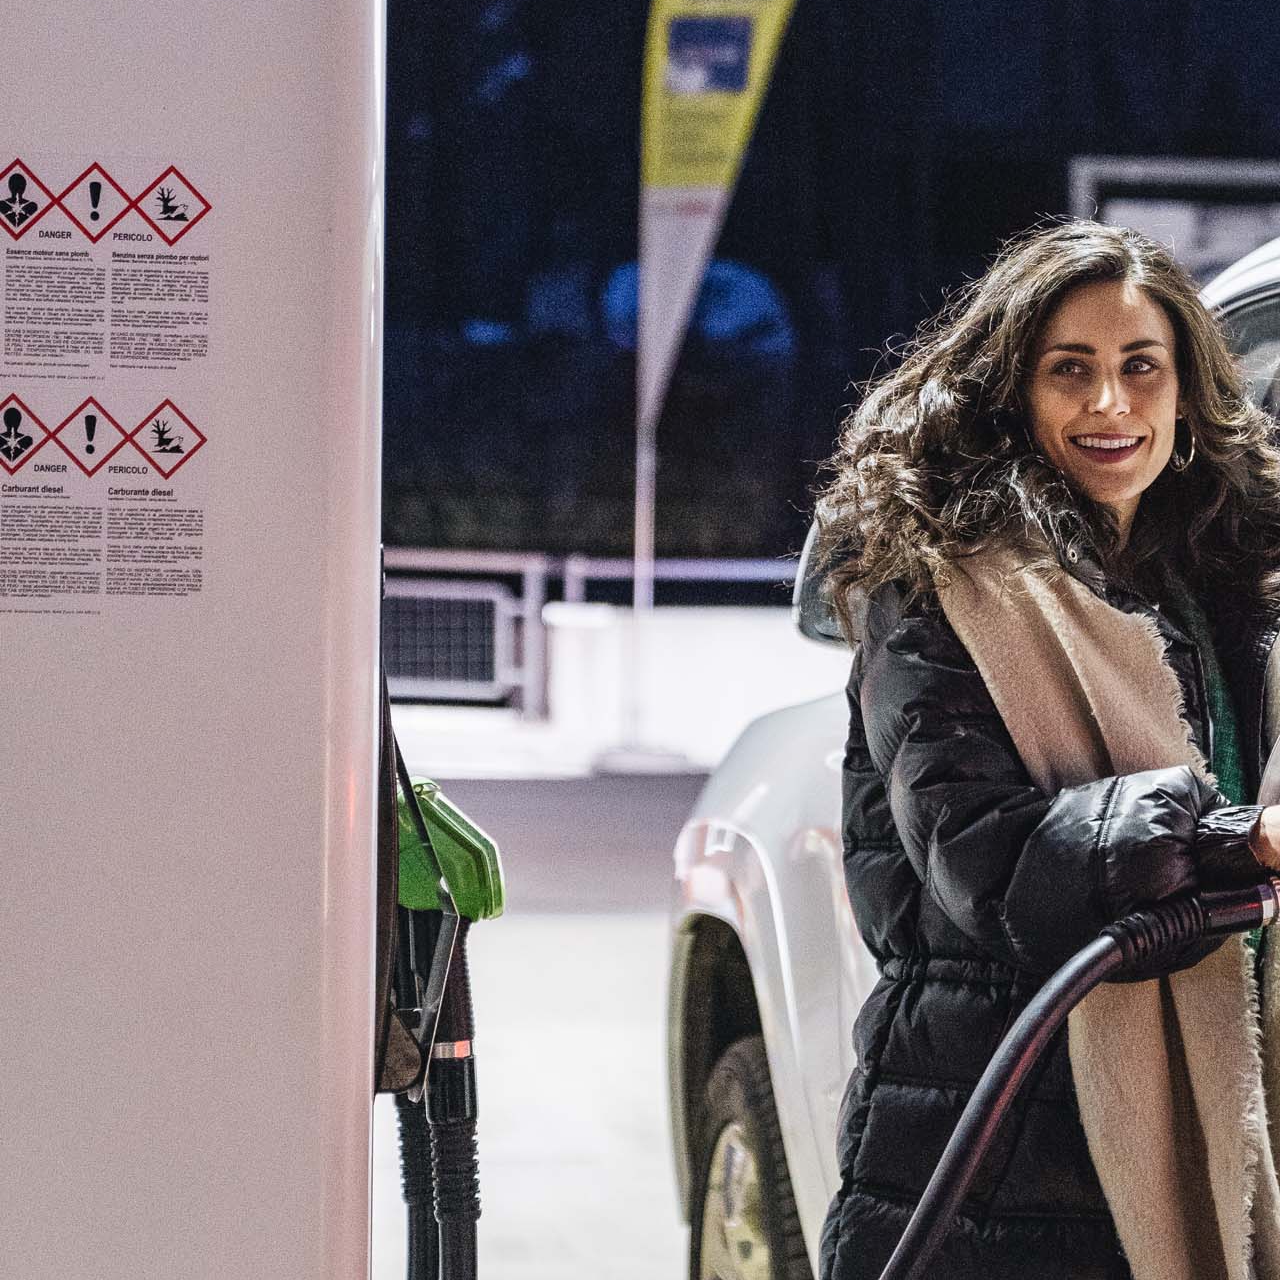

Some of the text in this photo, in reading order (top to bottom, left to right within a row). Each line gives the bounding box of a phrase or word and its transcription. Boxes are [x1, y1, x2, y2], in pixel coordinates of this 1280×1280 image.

[38, 230, 72, 240] DANGER
[112, 232, 153, 242] PERICOLO
[6, 248, 32, 256] Essence
[70, 250, 89, 258] plomb
[112, 251, 136, 259] Benzina
[155, 253, 177, 261] plombo
[34, 464, 67, 473] DANGER
[108, 465, 148, 475] PERICOLO
[1, 484, 64, 494] Carburant diesel
[108, 487, 174, 497] Carburante diesel
